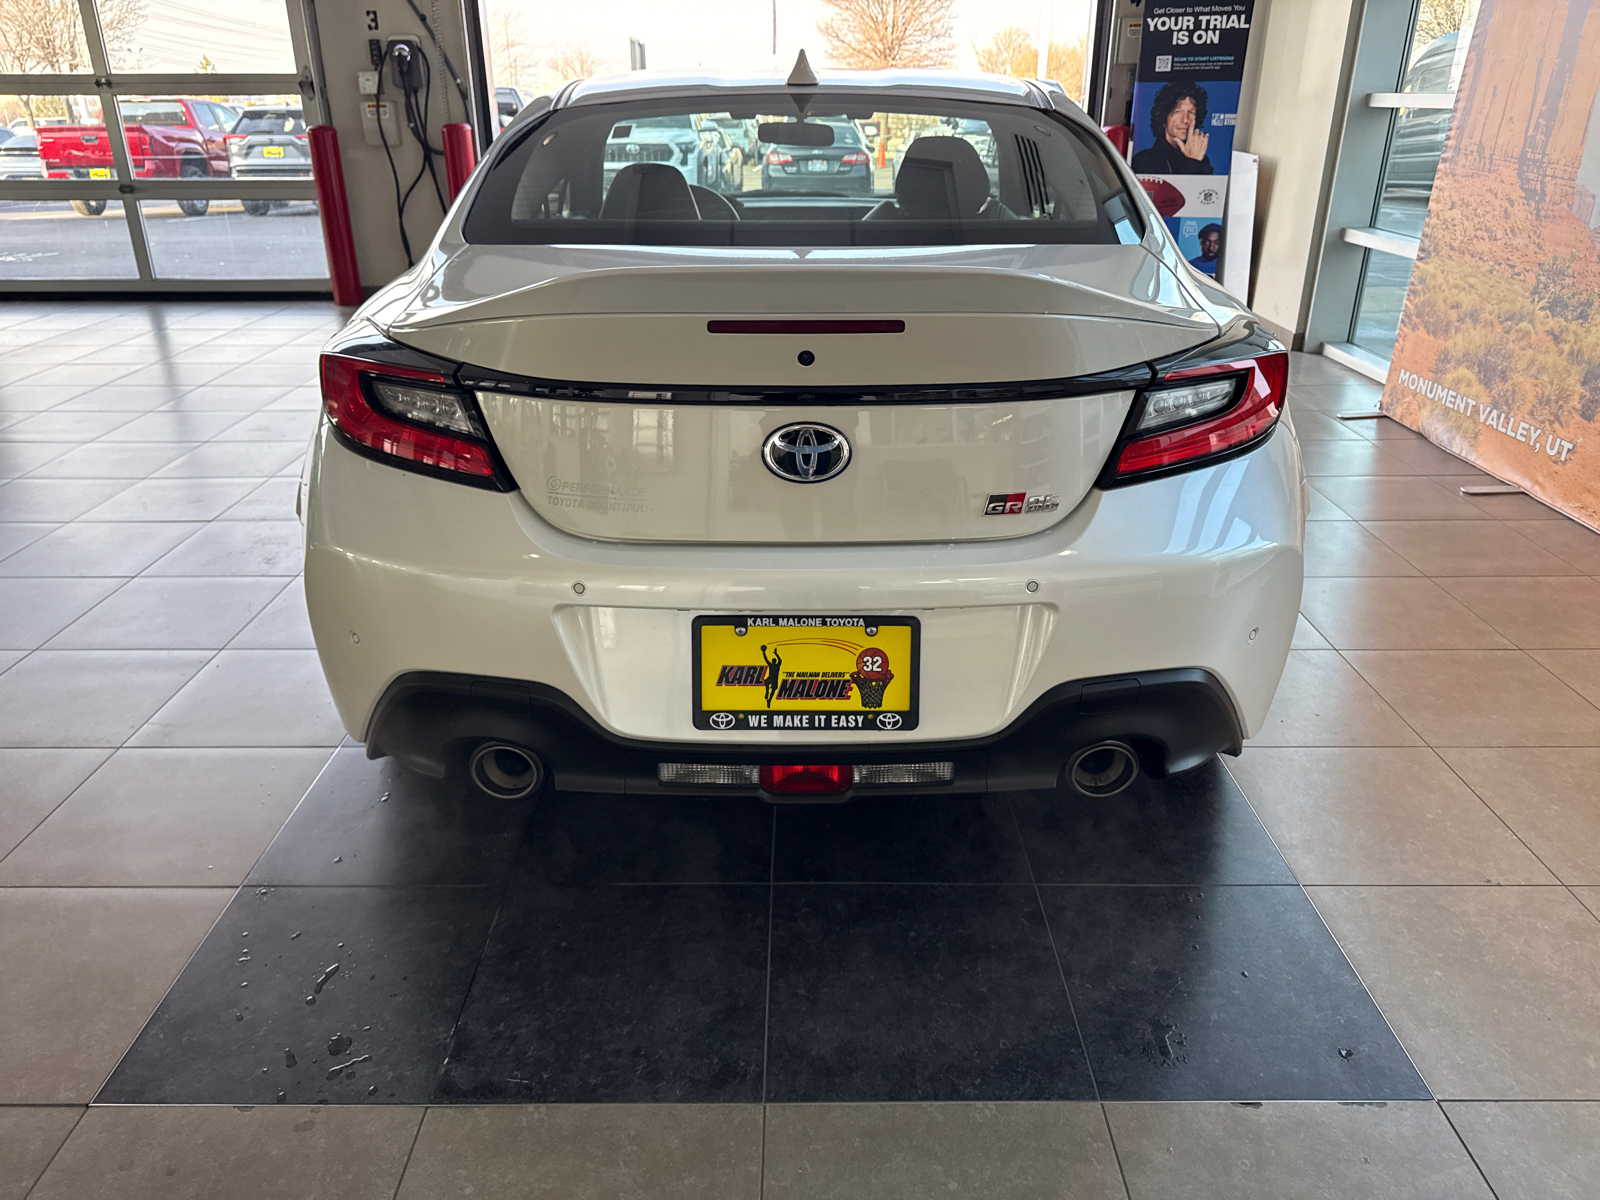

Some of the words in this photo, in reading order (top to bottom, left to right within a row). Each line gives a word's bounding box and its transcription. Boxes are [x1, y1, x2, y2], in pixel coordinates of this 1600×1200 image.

[1166, 6, 1185, 14] Closer
[1194, 5, 1210, 13] What
[366, 10, 379, 31] 3
[1146, 15, 1195, 32] YOUR
[1198, 14, 1250, 30] TRIAL
[1172, 30, 1189, 45] IS
[1192, 29, 1220, 45] ON
[1398, 368, 1476, 417] MONUMENT
[1478, 403, 1542, 453] VALLEY,
[1545, 433, 1574, 462] UT
[547, 495, 584, 509] TOYOTA
[587, 499, 645, 514] BOUNTIFUL
[986, 501, 1023, 514] GR
[747, 617, 776, 627] KARL
[778, 617, 823, 627] MALONE
[825, 617, 865, 627] TOYOTA
[863, 656, 882, 672] 32
[716, 665, 769, 686] KARL
[776, 679, 854, 700] MALONE
[748, 714, 768, 728] WE
[773, 714, 810, 728] MAKE
[814, 714, 826, 728] IT
[831, 714, 864, 728] EASY
